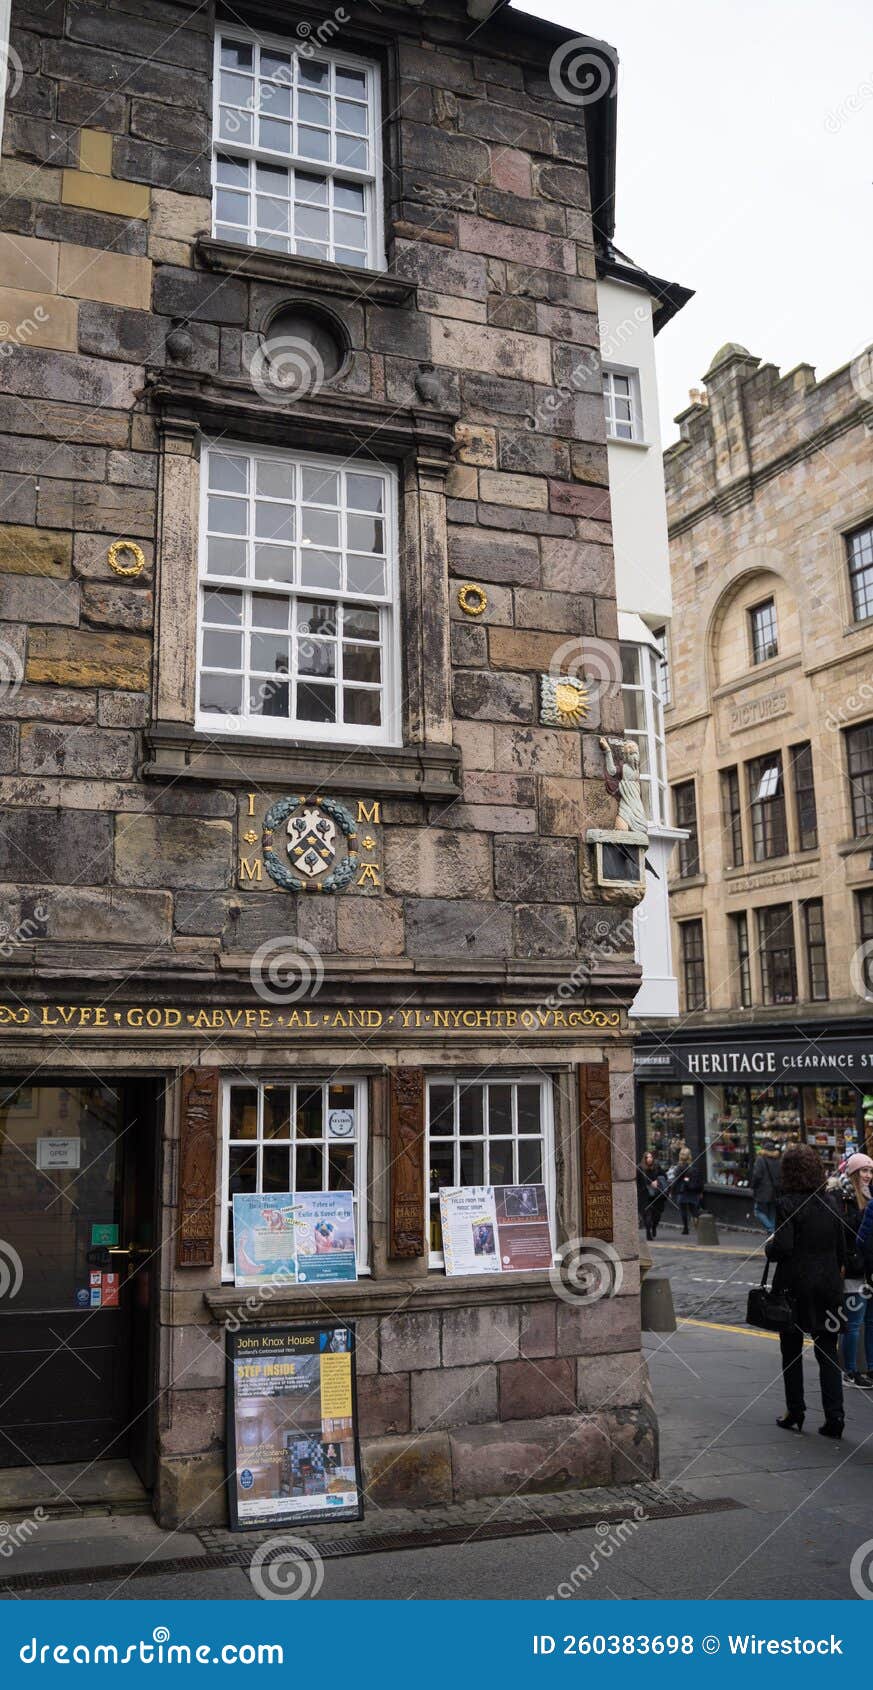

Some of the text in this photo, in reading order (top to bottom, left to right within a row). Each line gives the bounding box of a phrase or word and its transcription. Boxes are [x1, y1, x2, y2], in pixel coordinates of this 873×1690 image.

[731, 694, 787, 728] PICTURES
[127, 1007, 182, 1027] GOD
[287, 1009, 318, 1027] AL
[331, 1010, 382, 1027] AND
[687, 1052, 776, 1073] HERITAGE
[782, 1054, 854, 1068] CLEARANCE
[238, 1336, 315, 1348] John Knox House
[238, 1363, 296, 1377] STEP INSIDE
